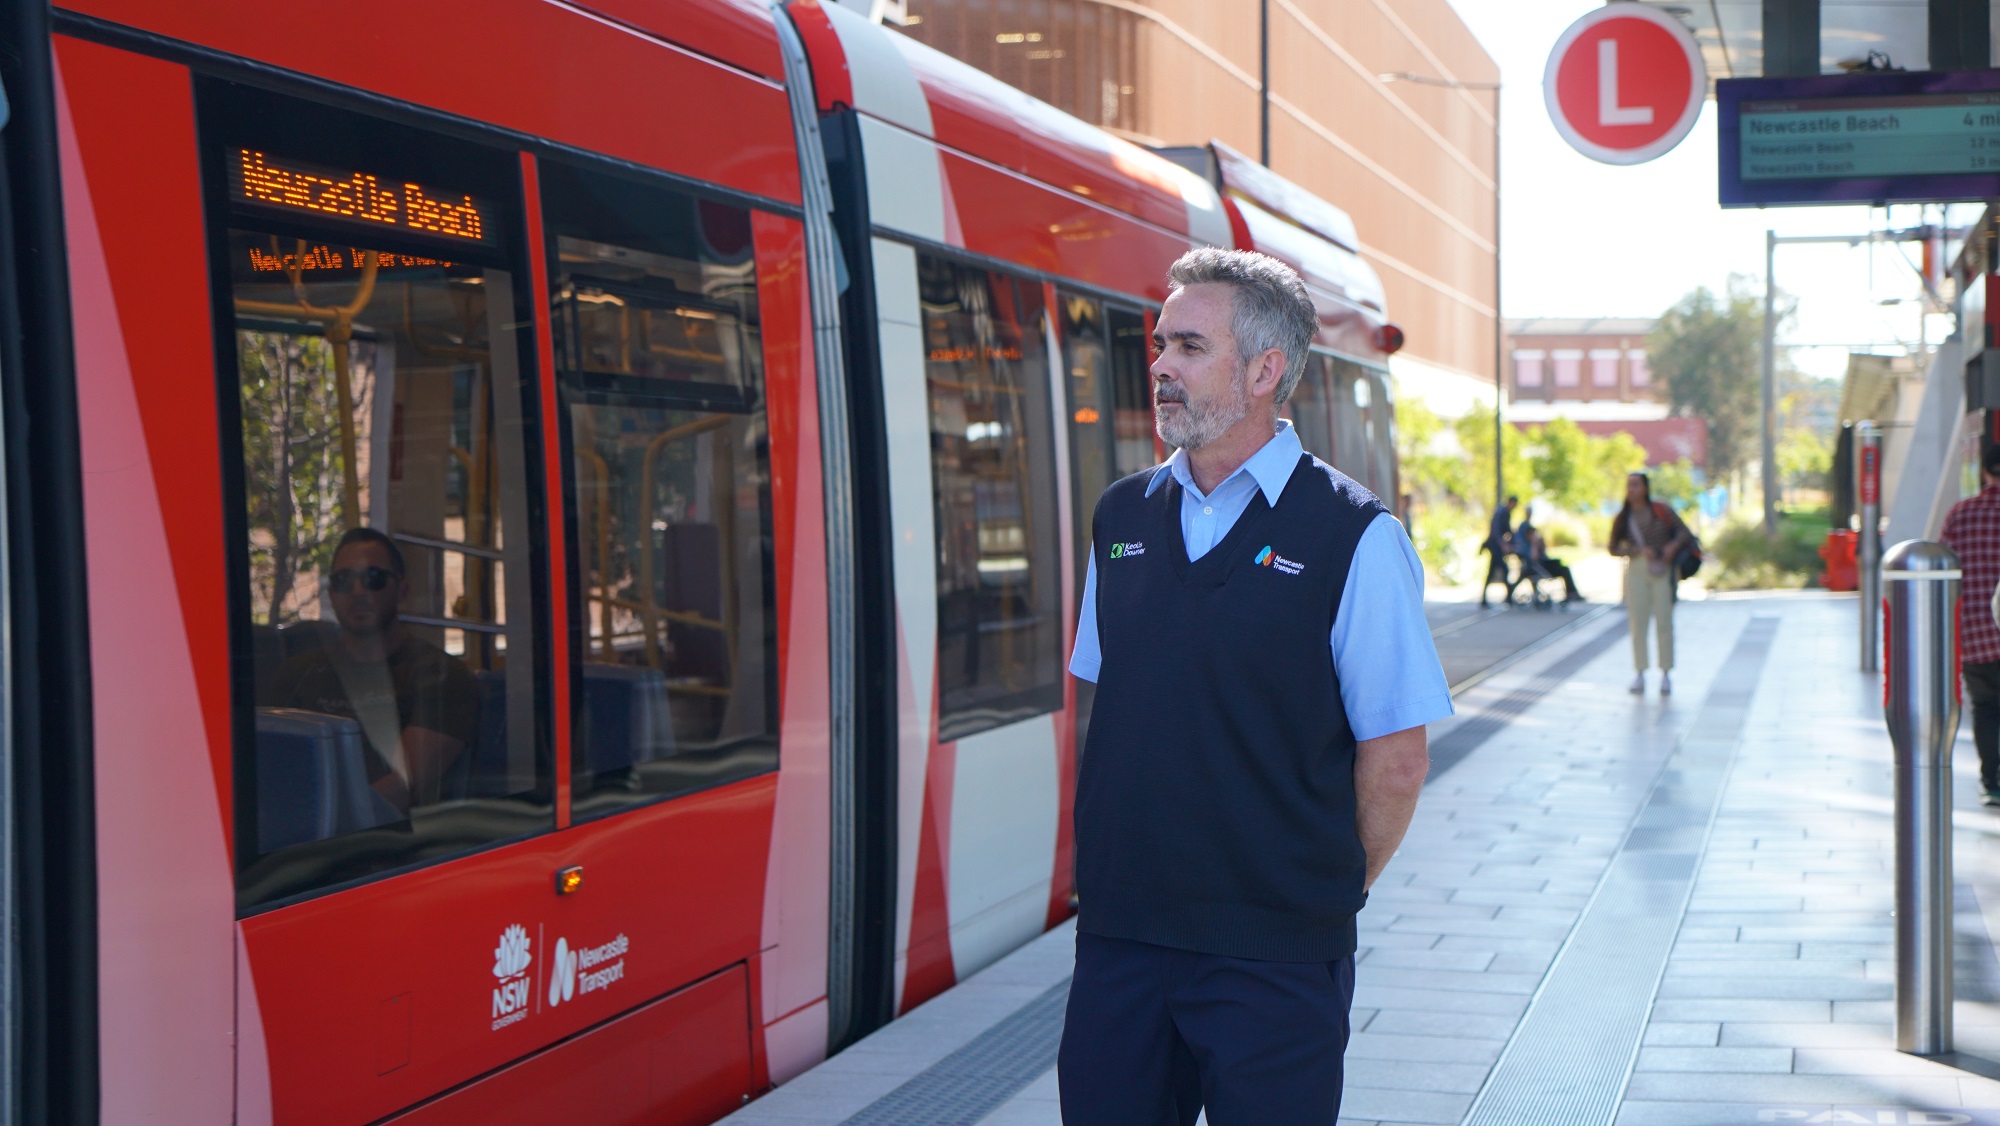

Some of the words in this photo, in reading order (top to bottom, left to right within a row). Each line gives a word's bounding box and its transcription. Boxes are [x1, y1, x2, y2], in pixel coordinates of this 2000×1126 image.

[1598, 38, 1654, 127] L
[1749, 117, 1841, 135] Newcastle
[1845, 113, 1900, 132] Beach
[1963, 110, 1975, 127] 4
[241, 149, 397, 223] Newcastle
[404, 182, 482, 239] Beach
[1273, 561, 1300, 576] Transport
[1274, 554, 1305, 571] Newcastle
[578, 932, 630, 971] Newcastle
[577, 957, 624, 995] Transport
[492, 976, 531, 1019] NSW
[1756, 1109, 1973, 1126] PAID
